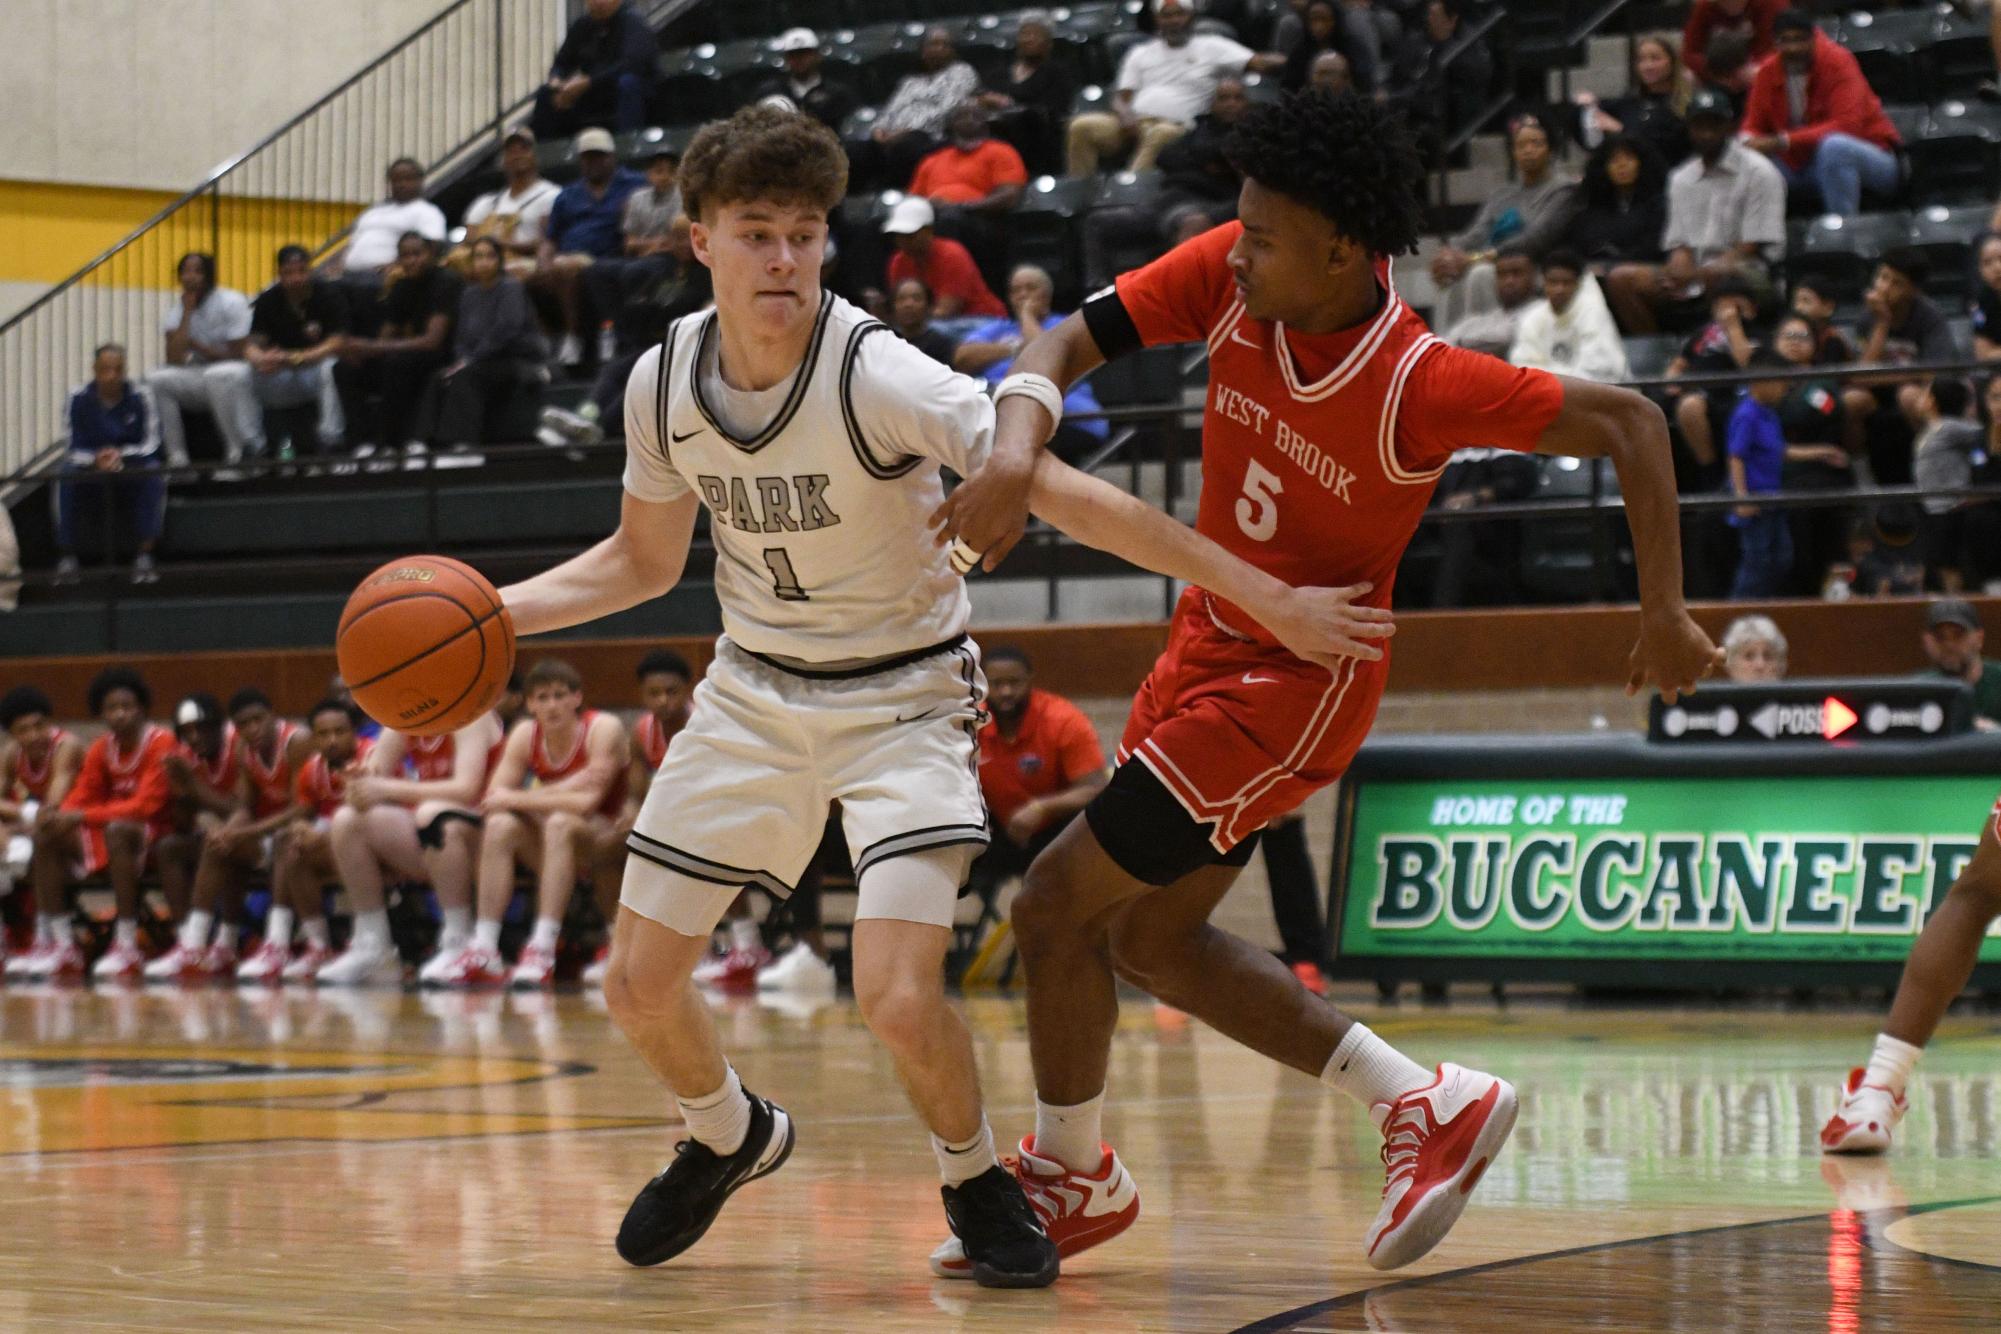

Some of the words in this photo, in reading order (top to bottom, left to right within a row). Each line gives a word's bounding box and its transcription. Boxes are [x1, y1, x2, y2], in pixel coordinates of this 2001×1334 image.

[1215, 384, 1270, 435] WEST
[1275, 419, 1357, 505] BROOK
[698, 474, 841, 533] PARK
[1235, 457, 1284, 542] 5
[763, 548, 809, 601] 1
[1430, 796, 1518, 826] HOME
[1520, 796, 1566, 825] OF
[1568, 796, 1628, 825] THE
[1370, 834, 2001, 936] BUCCANEE
